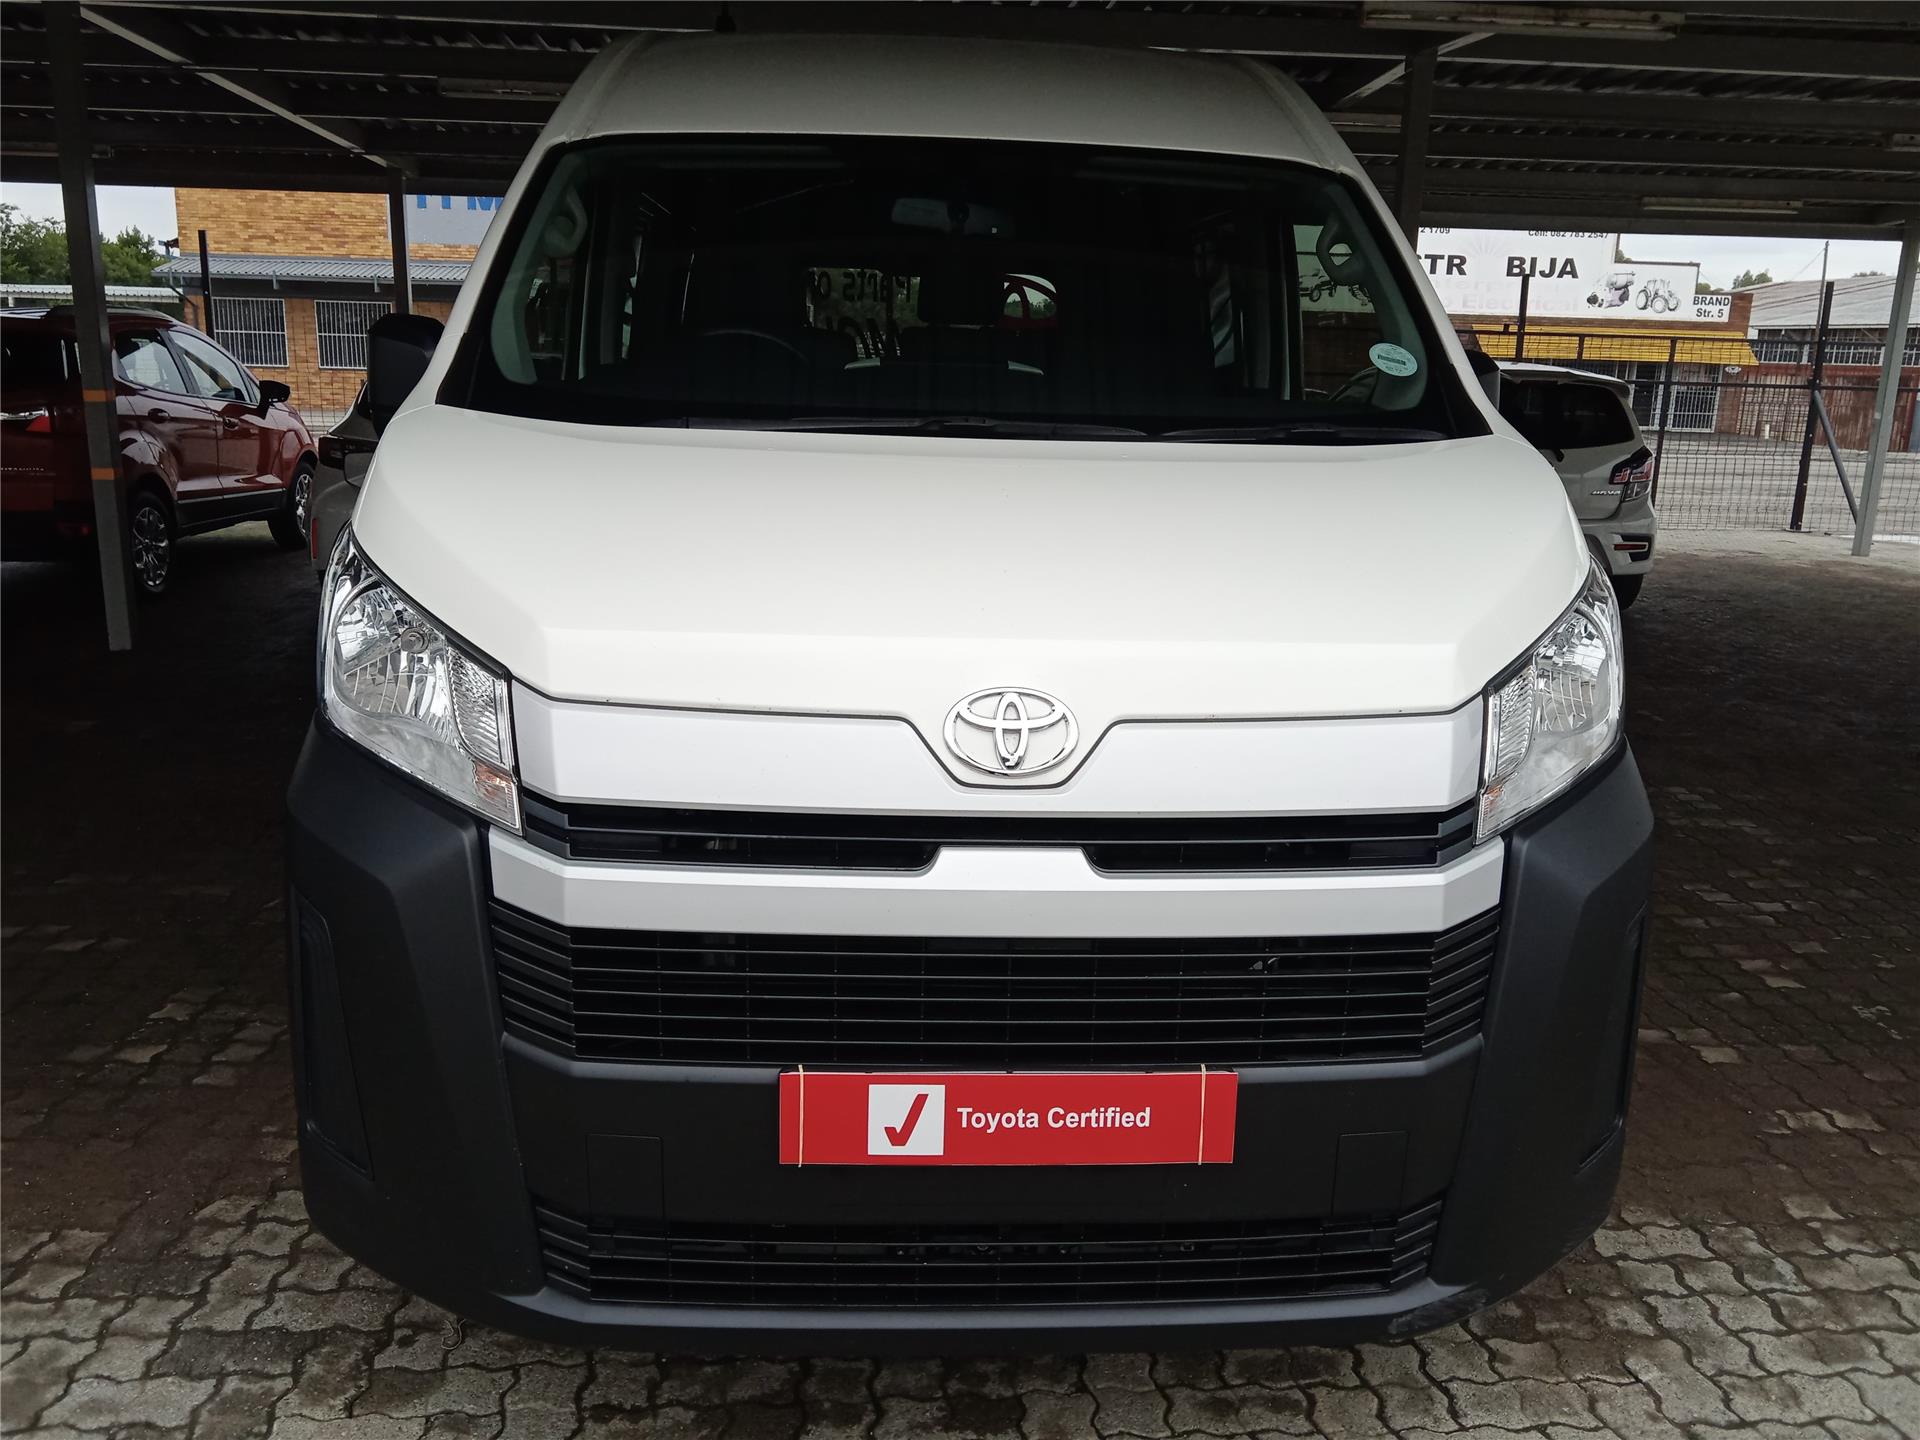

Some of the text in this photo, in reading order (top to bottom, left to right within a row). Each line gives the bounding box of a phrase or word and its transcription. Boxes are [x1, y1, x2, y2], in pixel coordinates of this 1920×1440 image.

[1506, 256, 1579, 279] BIJA
[1693, 296, 1730, 306] BRAND
[1696, 308, 1724, 318] Str. 5
[956, 1107, 1151, 1134] Toyota Certified
